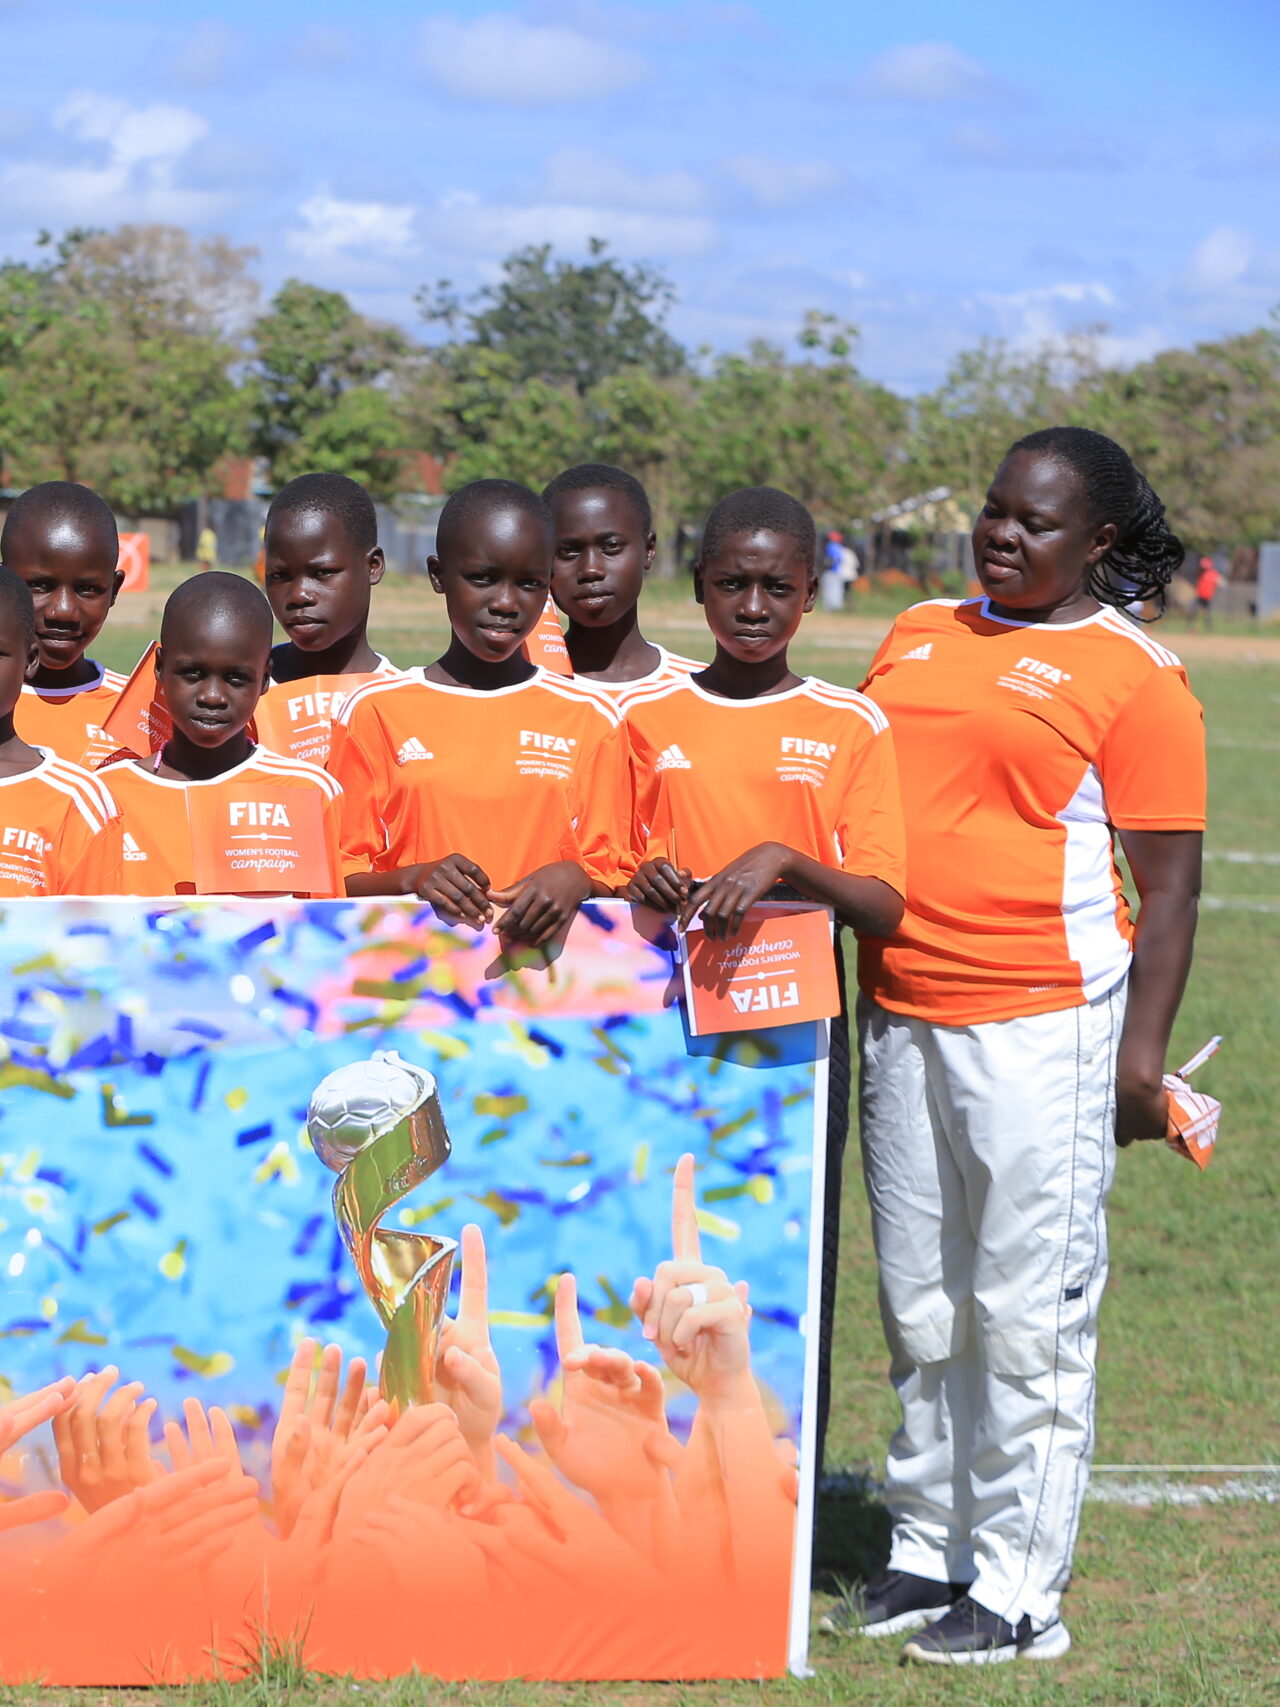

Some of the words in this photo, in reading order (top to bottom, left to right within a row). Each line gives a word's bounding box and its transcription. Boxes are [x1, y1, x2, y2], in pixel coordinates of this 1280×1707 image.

[296, 744, 331, 760] camp
[229, 802, 291, 827] FIFA
[123, 851, 147, 861] das
[225, 848, 263, 857] WOMEN'S
[265, 848, 300, 858] FOOTBALL
[230, 855, 295, 873] campaign
[729, 982, 800, 1013] FIFA
